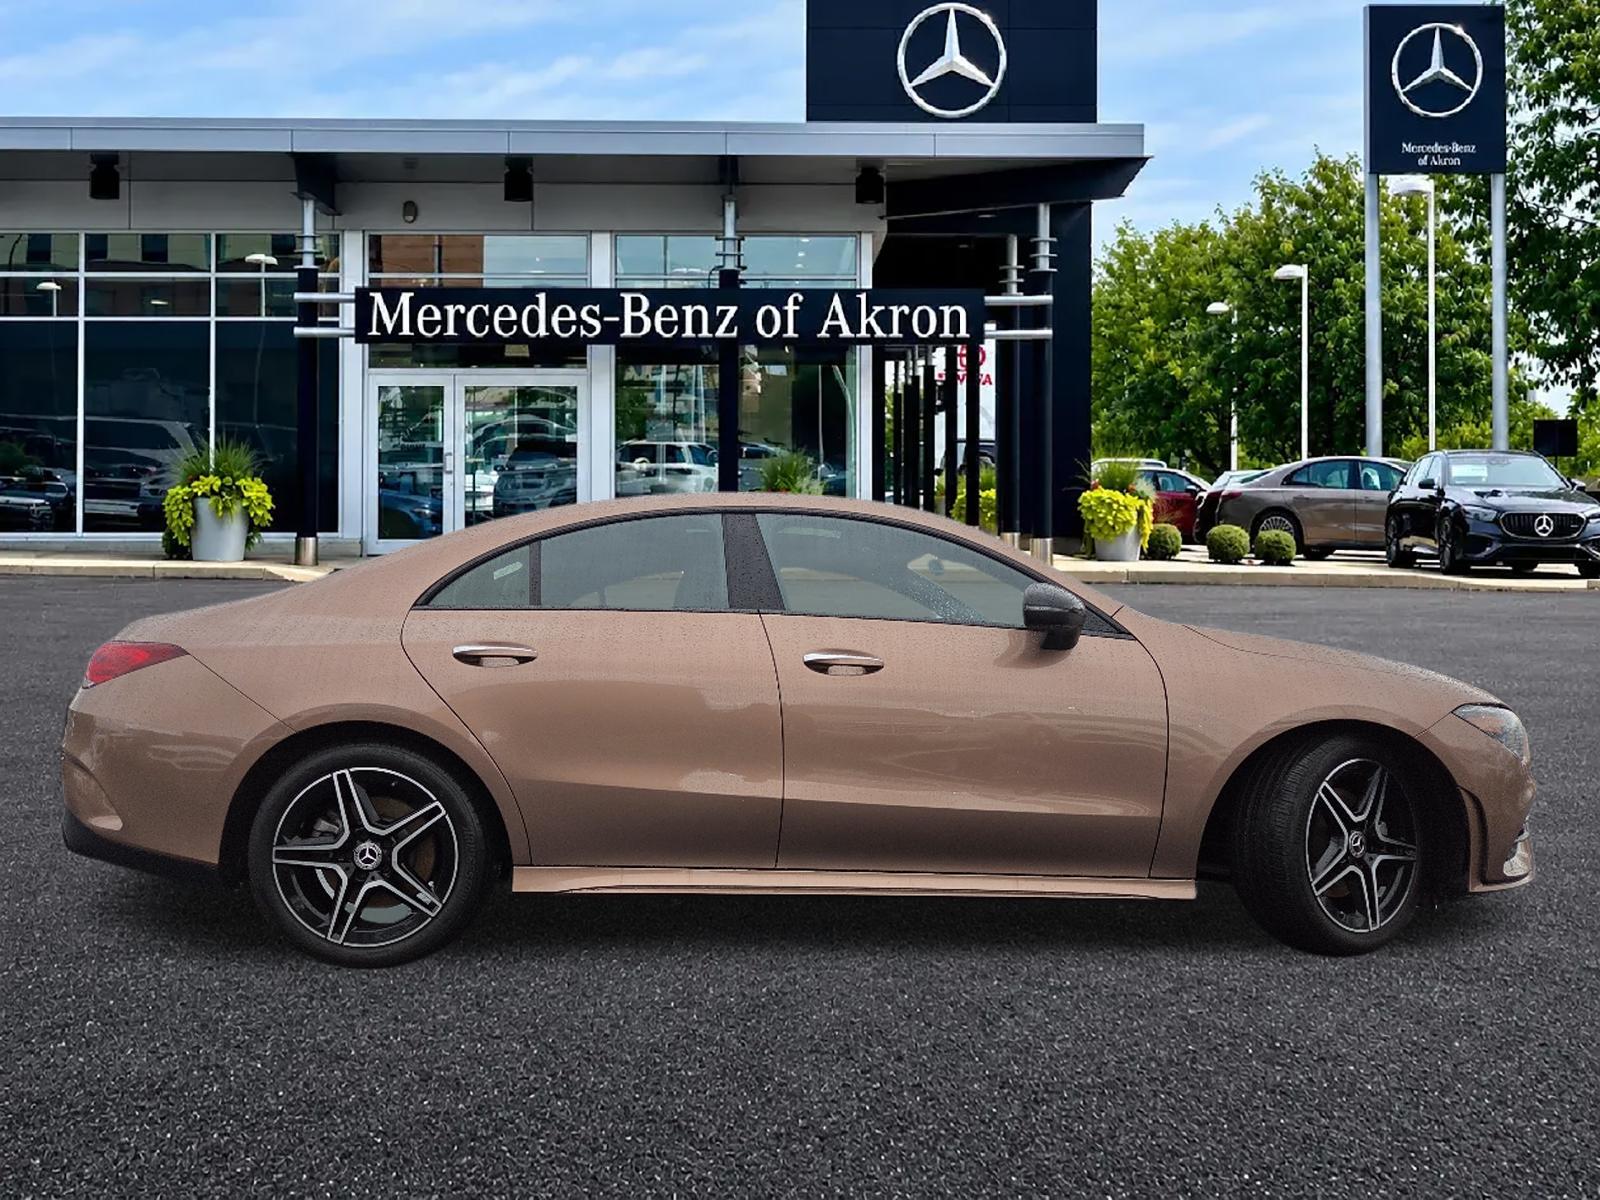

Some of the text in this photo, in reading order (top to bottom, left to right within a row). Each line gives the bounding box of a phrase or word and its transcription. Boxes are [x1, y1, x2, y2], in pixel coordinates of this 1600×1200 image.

[1401, 141, 1476, 153] Mercedes-Benz
[1417, 154, 1461, 166] of Akron
[367, 291, 971, 338] Mercedes-Benz of Akron
